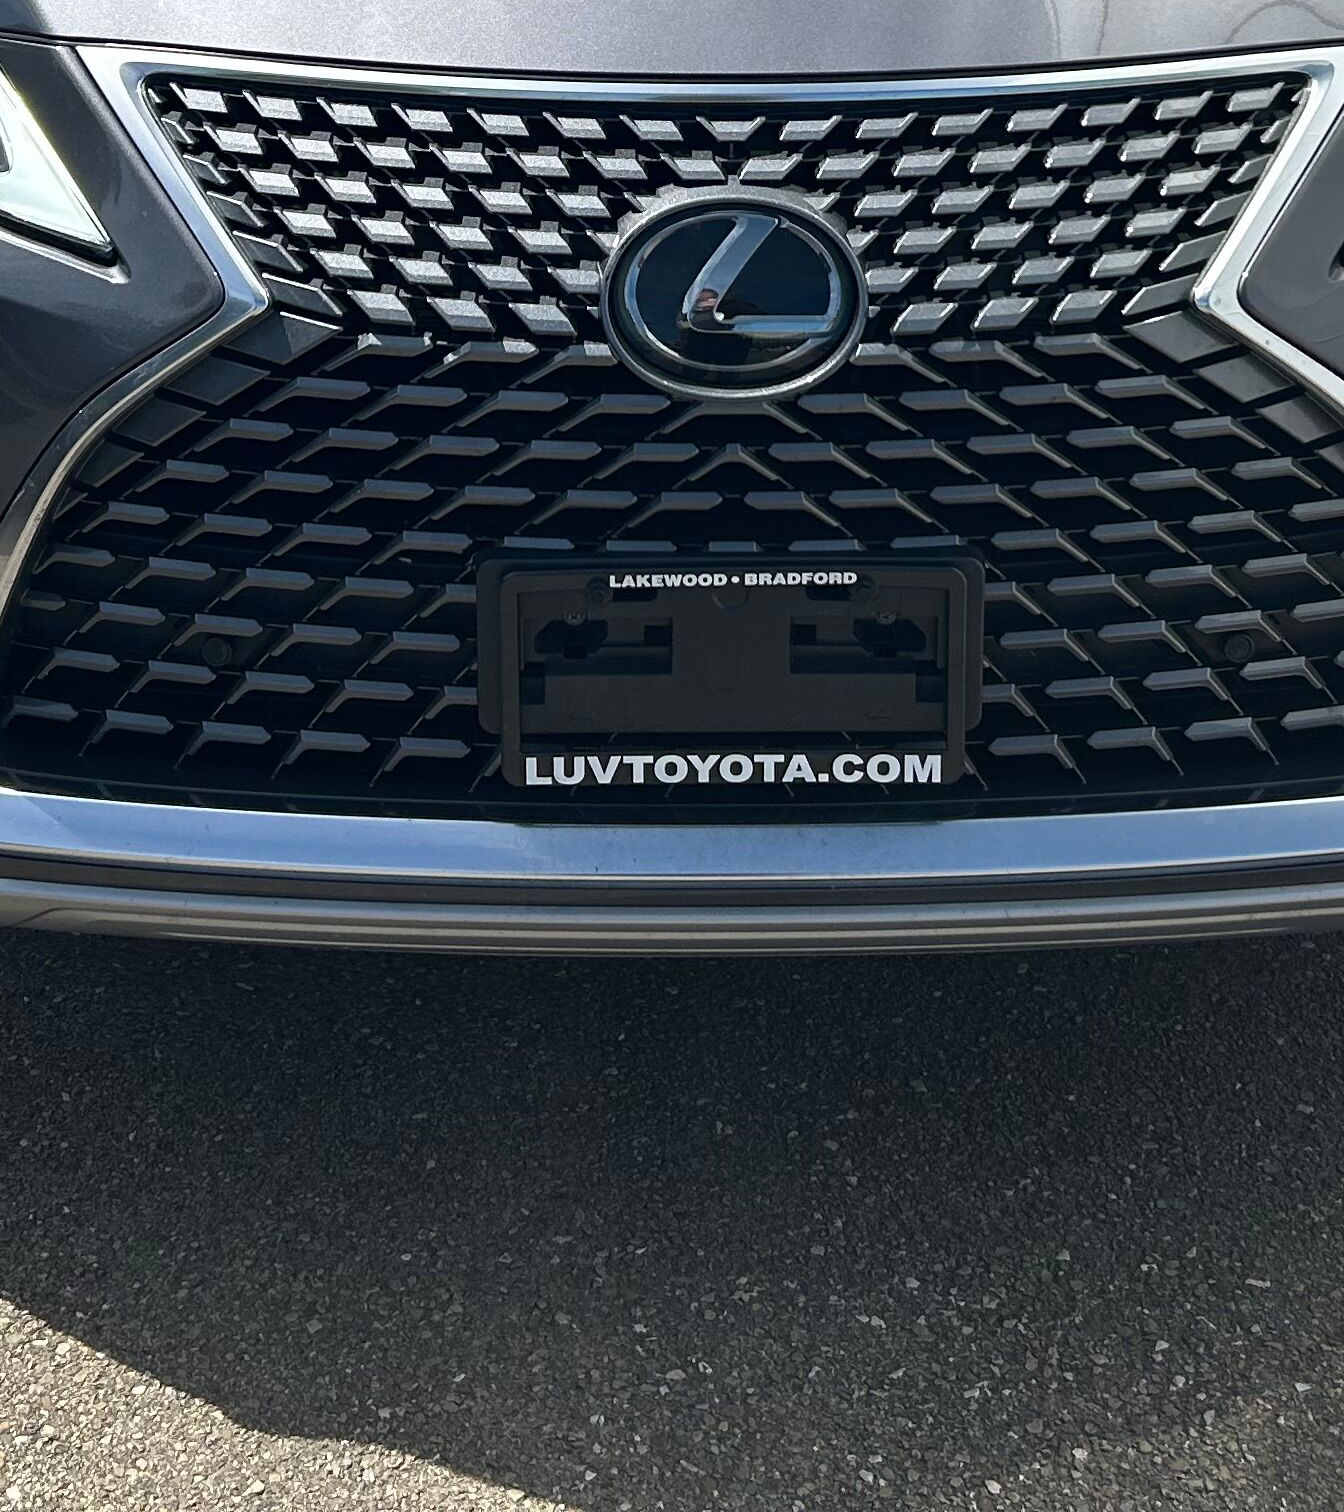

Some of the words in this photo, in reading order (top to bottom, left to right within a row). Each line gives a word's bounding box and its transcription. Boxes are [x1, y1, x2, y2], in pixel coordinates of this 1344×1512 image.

[609, 573, 728, 588] LAKEWOOD
[744, 571, 858, 586] BRADFORD
[525, 753, 942, 786] LUVTOYOTA.COM
